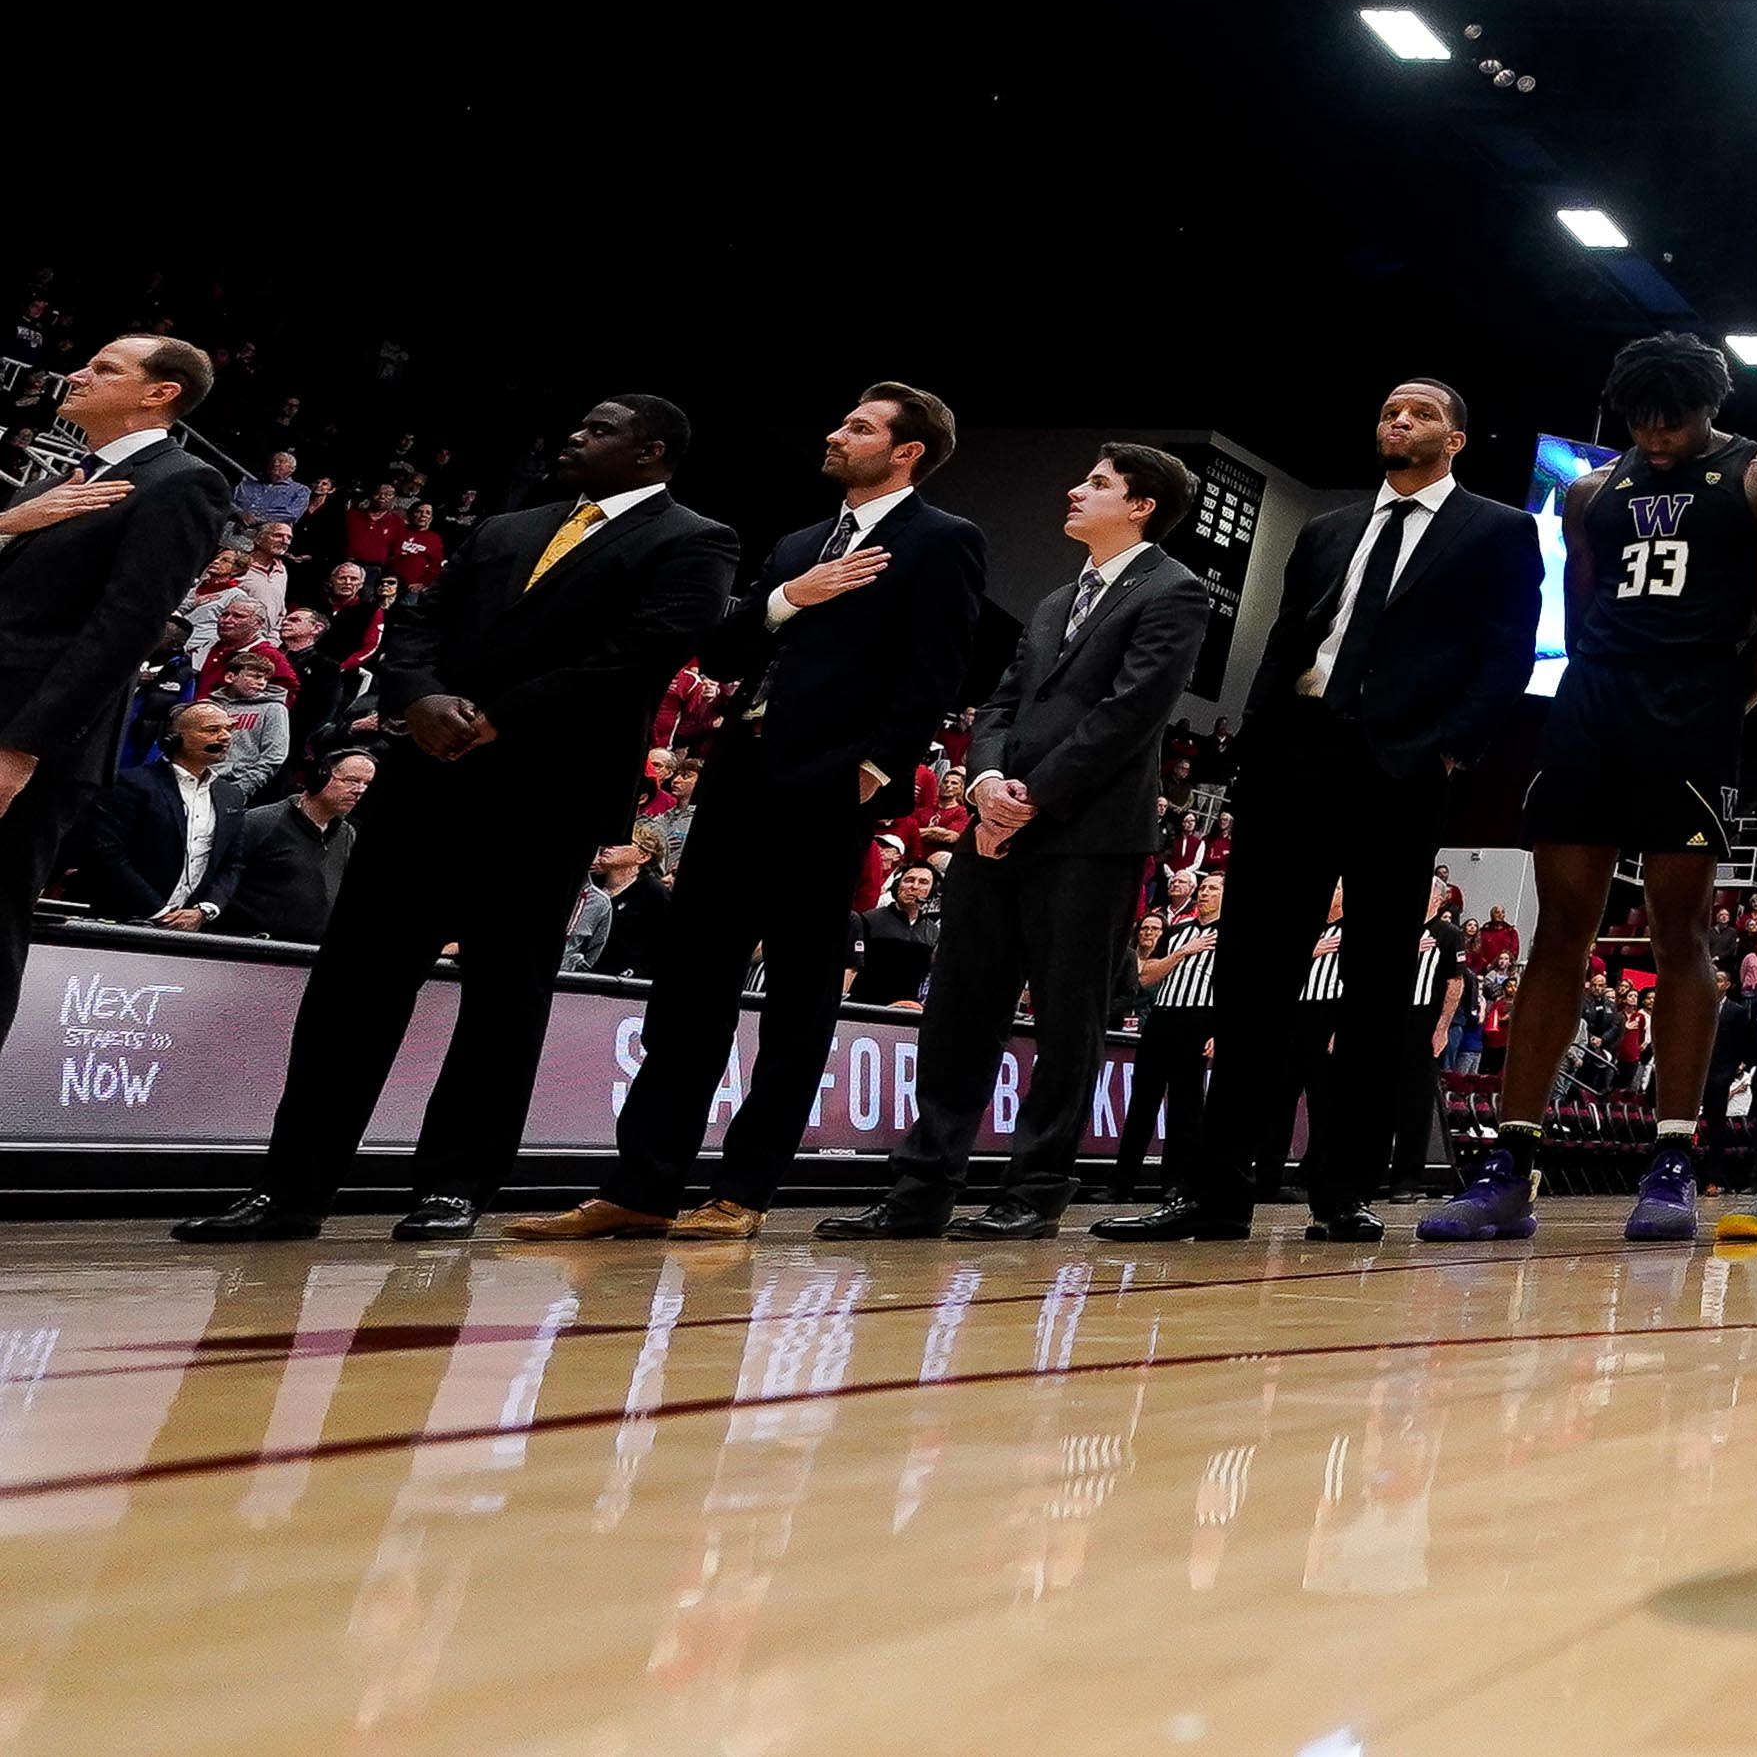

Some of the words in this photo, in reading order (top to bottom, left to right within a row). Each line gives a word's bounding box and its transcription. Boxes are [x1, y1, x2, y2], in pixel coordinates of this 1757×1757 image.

[1628, 494, 1694, 539] W
[1617, 540, 1689, 599] 33
[60, 973, 184, 1026] NEXT
[60, 1051, 160, 1107] NOW
